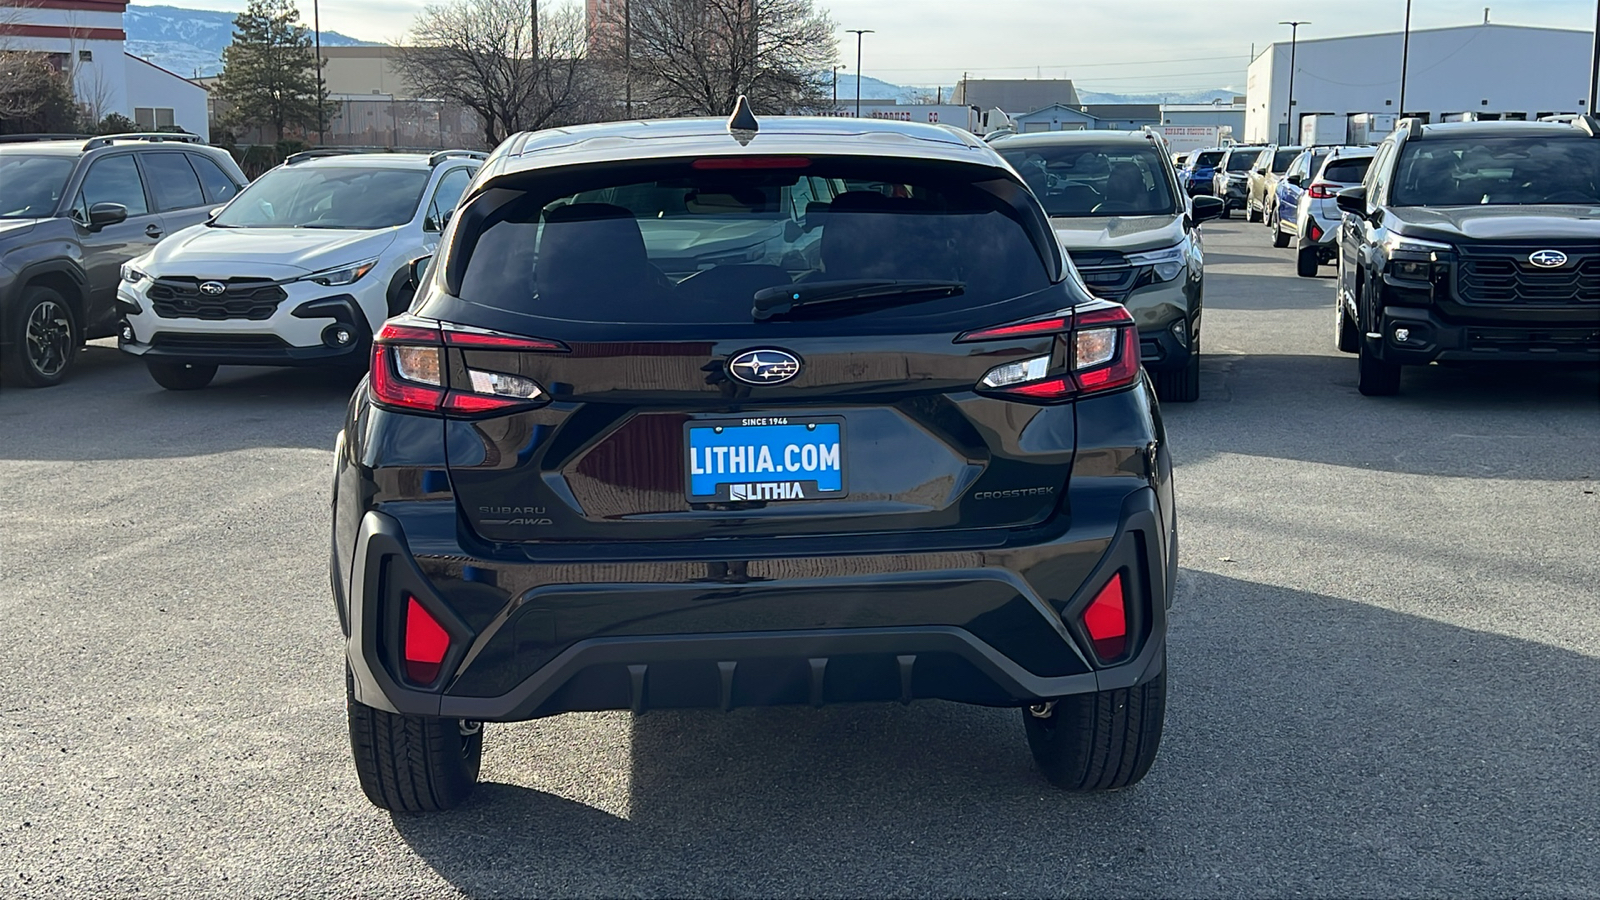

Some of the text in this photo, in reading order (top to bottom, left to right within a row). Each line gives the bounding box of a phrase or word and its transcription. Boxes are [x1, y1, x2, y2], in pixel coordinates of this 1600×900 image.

[742, 417, 788, 426] SINCE 1946
[690, 443, 841, 475] LITHIA.COM
[746, 482, 805, 500] LITHIA
[974, 486, 1054, 500] CROSSTREK
[479, 506, 546, 514] SUBARU
